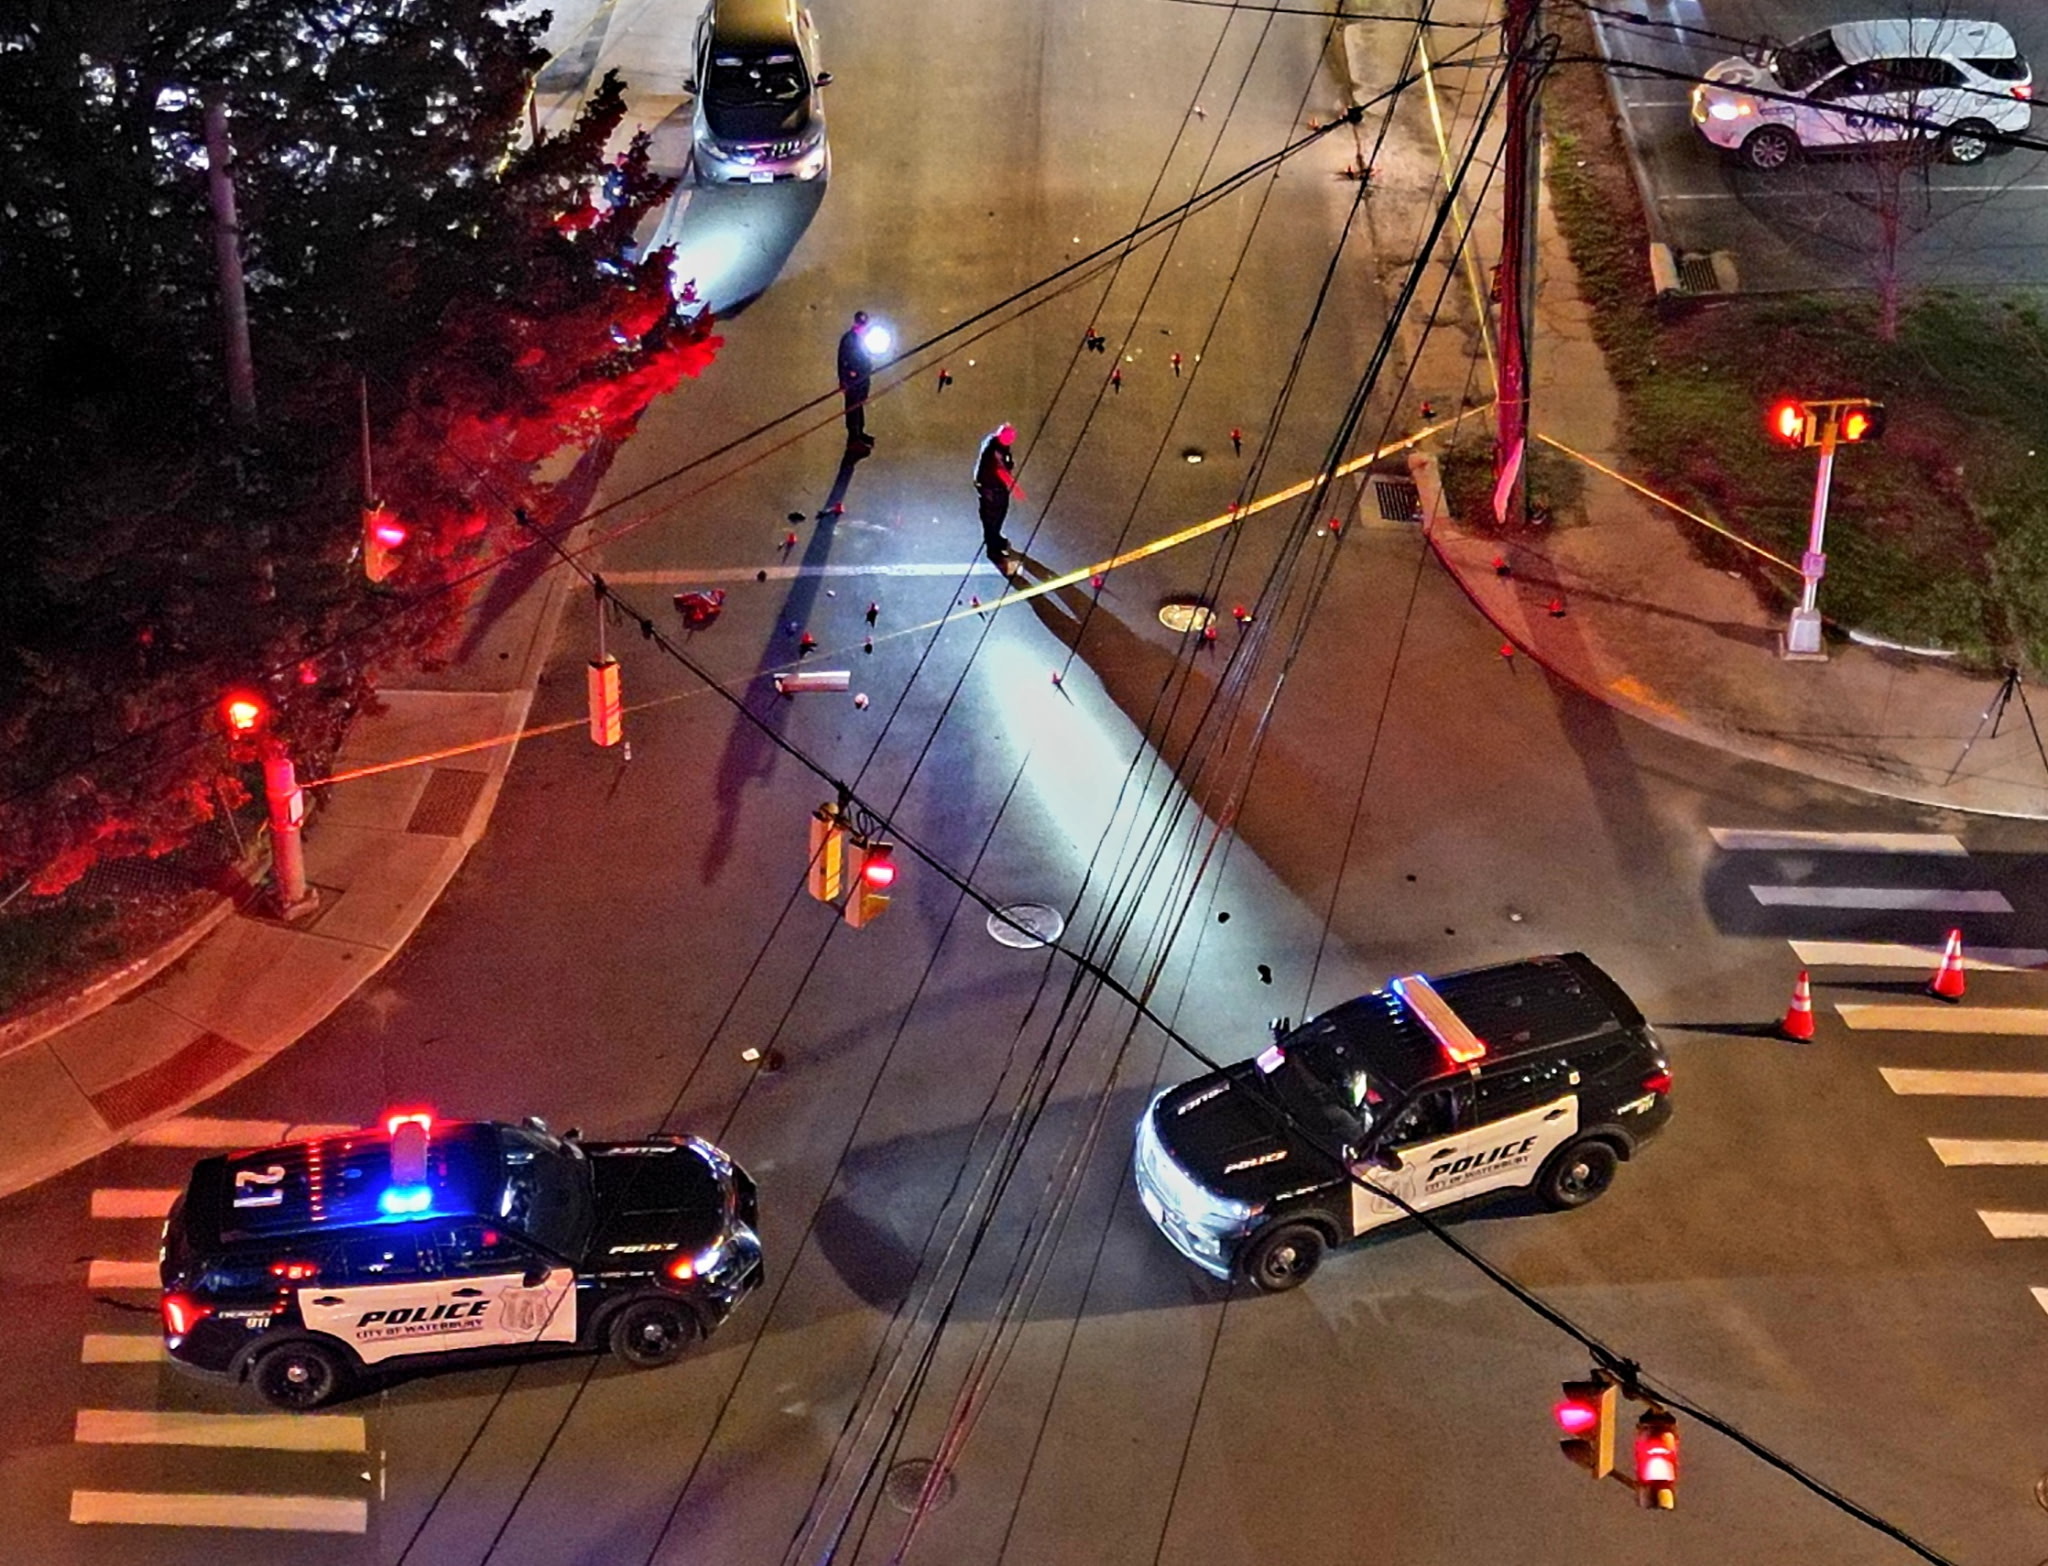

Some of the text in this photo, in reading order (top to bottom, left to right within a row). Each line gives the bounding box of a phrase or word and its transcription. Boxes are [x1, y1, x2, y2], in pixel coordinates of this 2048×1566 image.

[1426, 1136, 1538, 1182] POLICE
[1450, 1173, 1463, 1184] OF
[356, 1300, 491, 1328] POLICE
[356, 1319, 483, 1340] CITY OF WATERBURY
